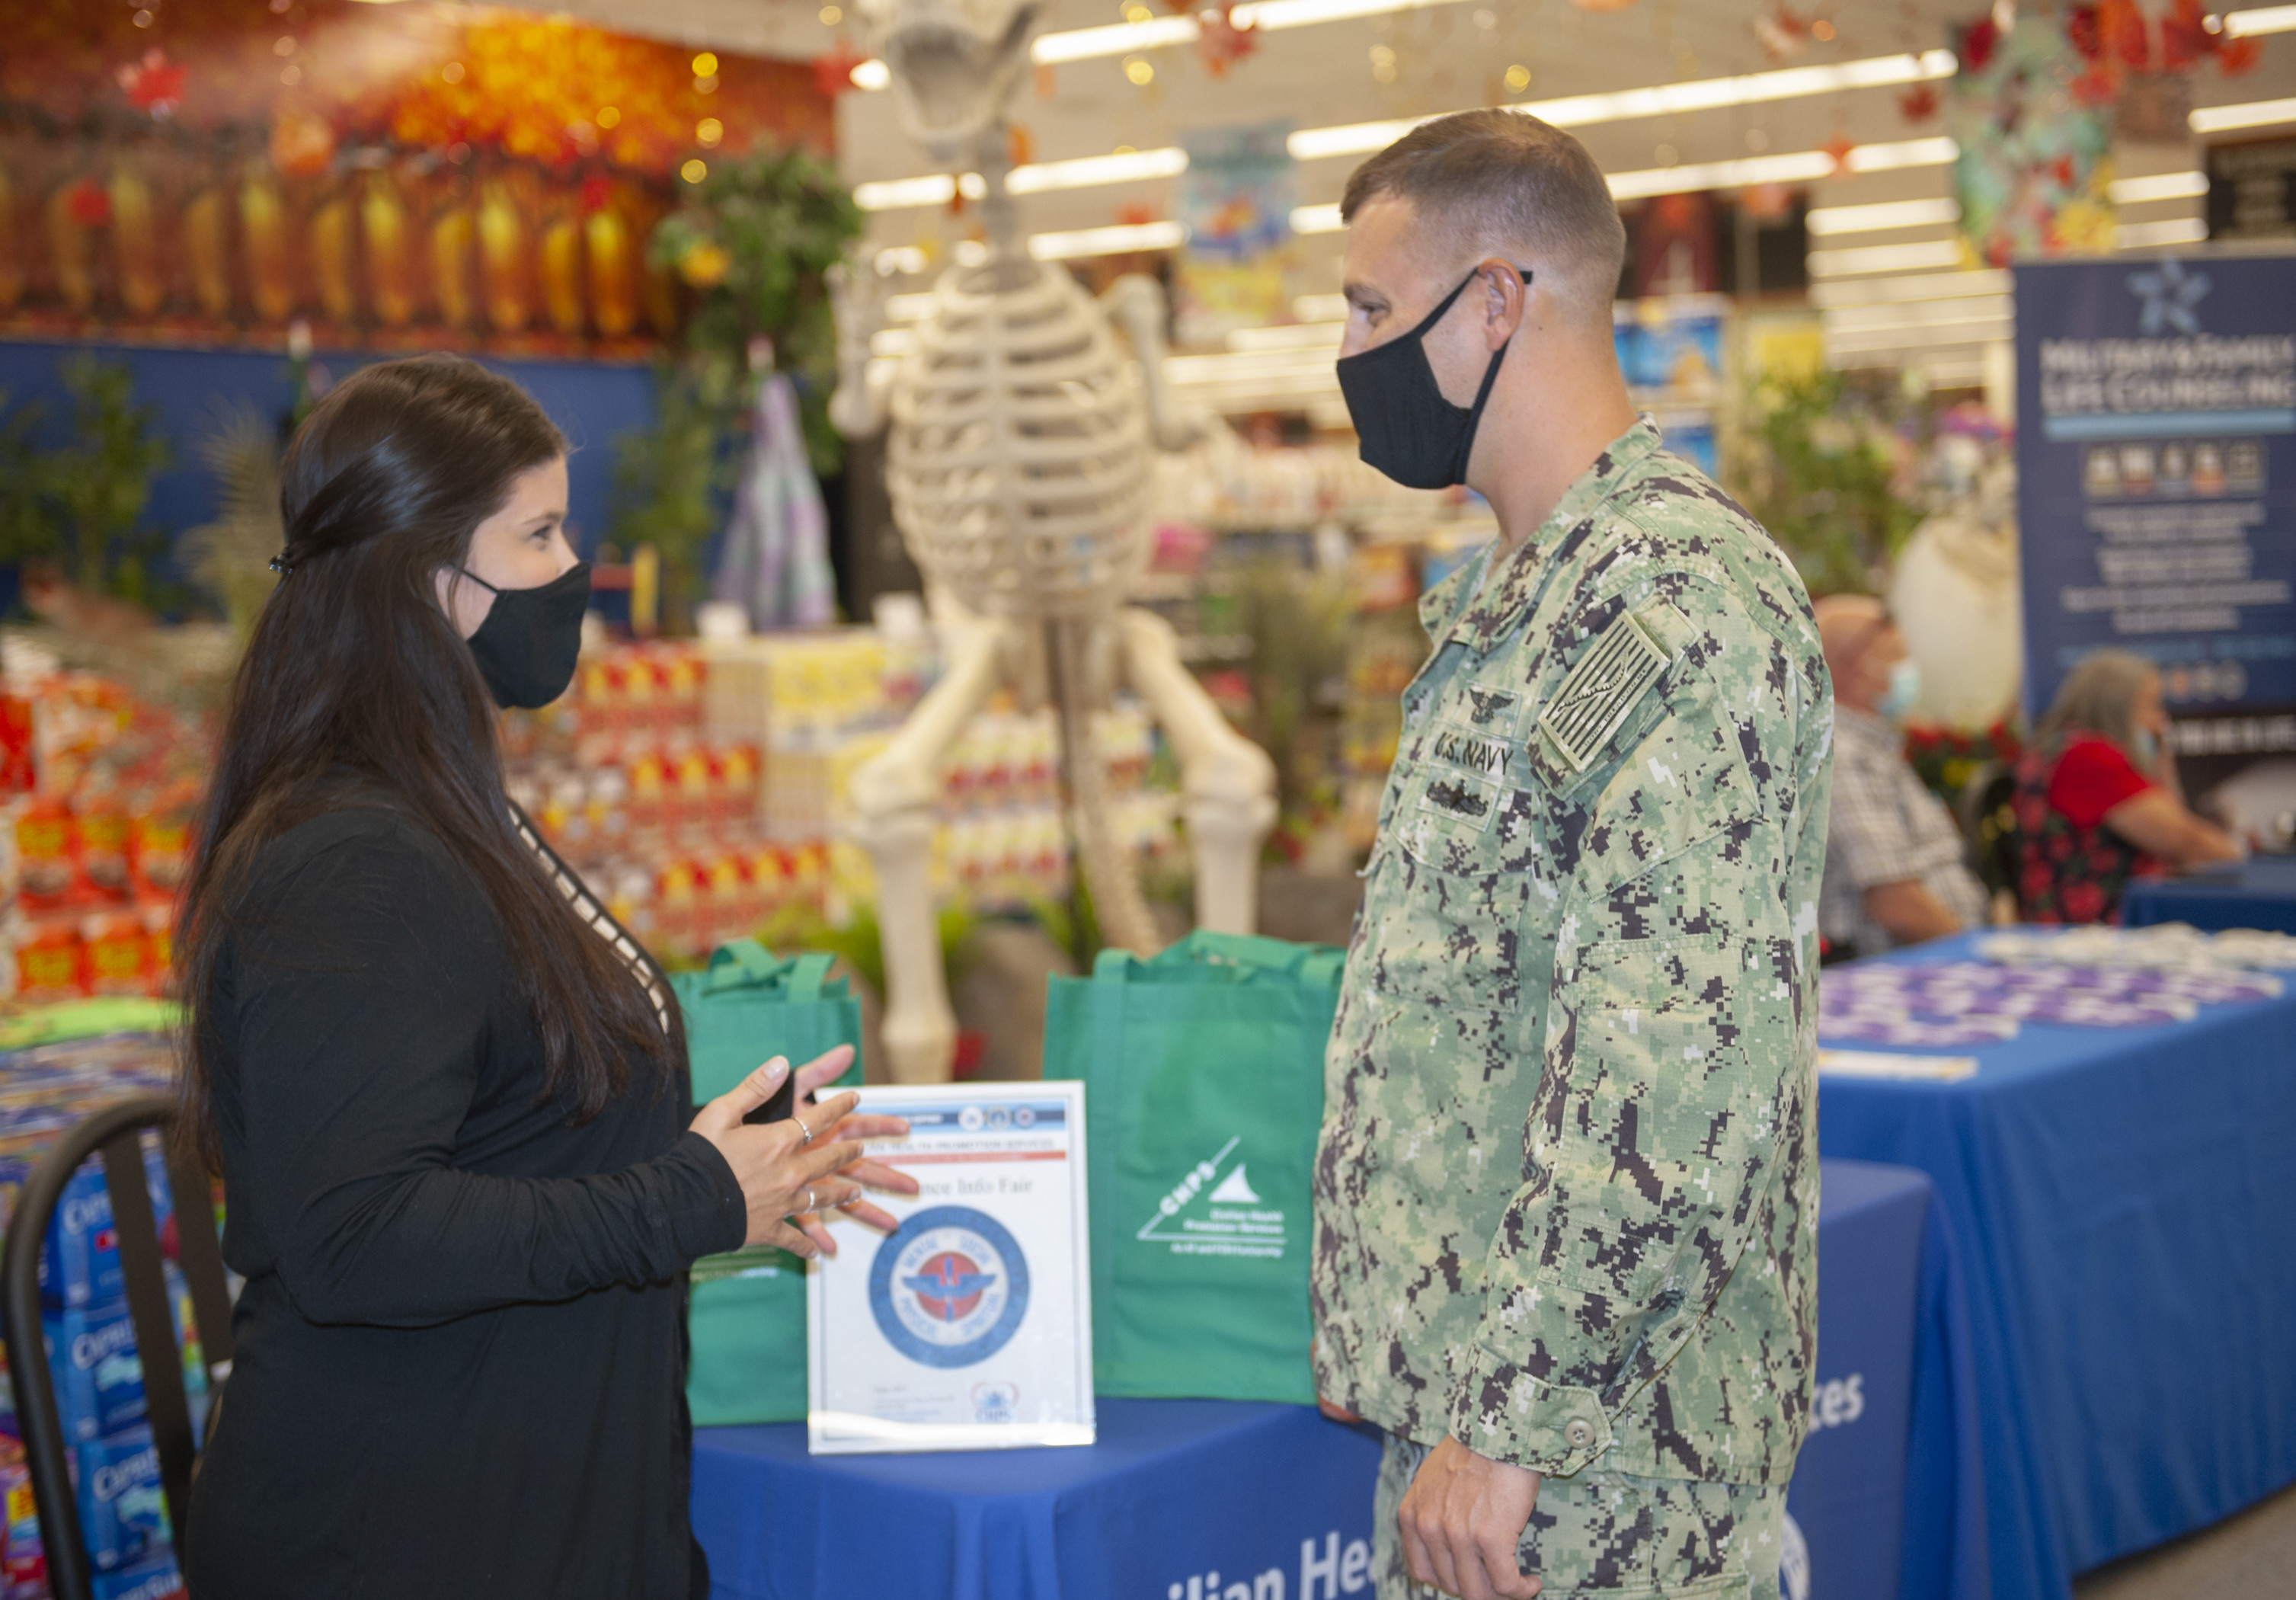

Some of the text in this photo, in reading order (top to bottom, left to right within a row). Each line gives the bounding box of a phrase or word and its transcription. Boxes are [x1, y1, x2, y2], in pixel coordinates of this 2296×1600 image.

[1434, 731, 1514, 776] U.S. NAVY
[957, 1176, 993, 1194] Info
[999, 1176, 1034, 1192] Fair
